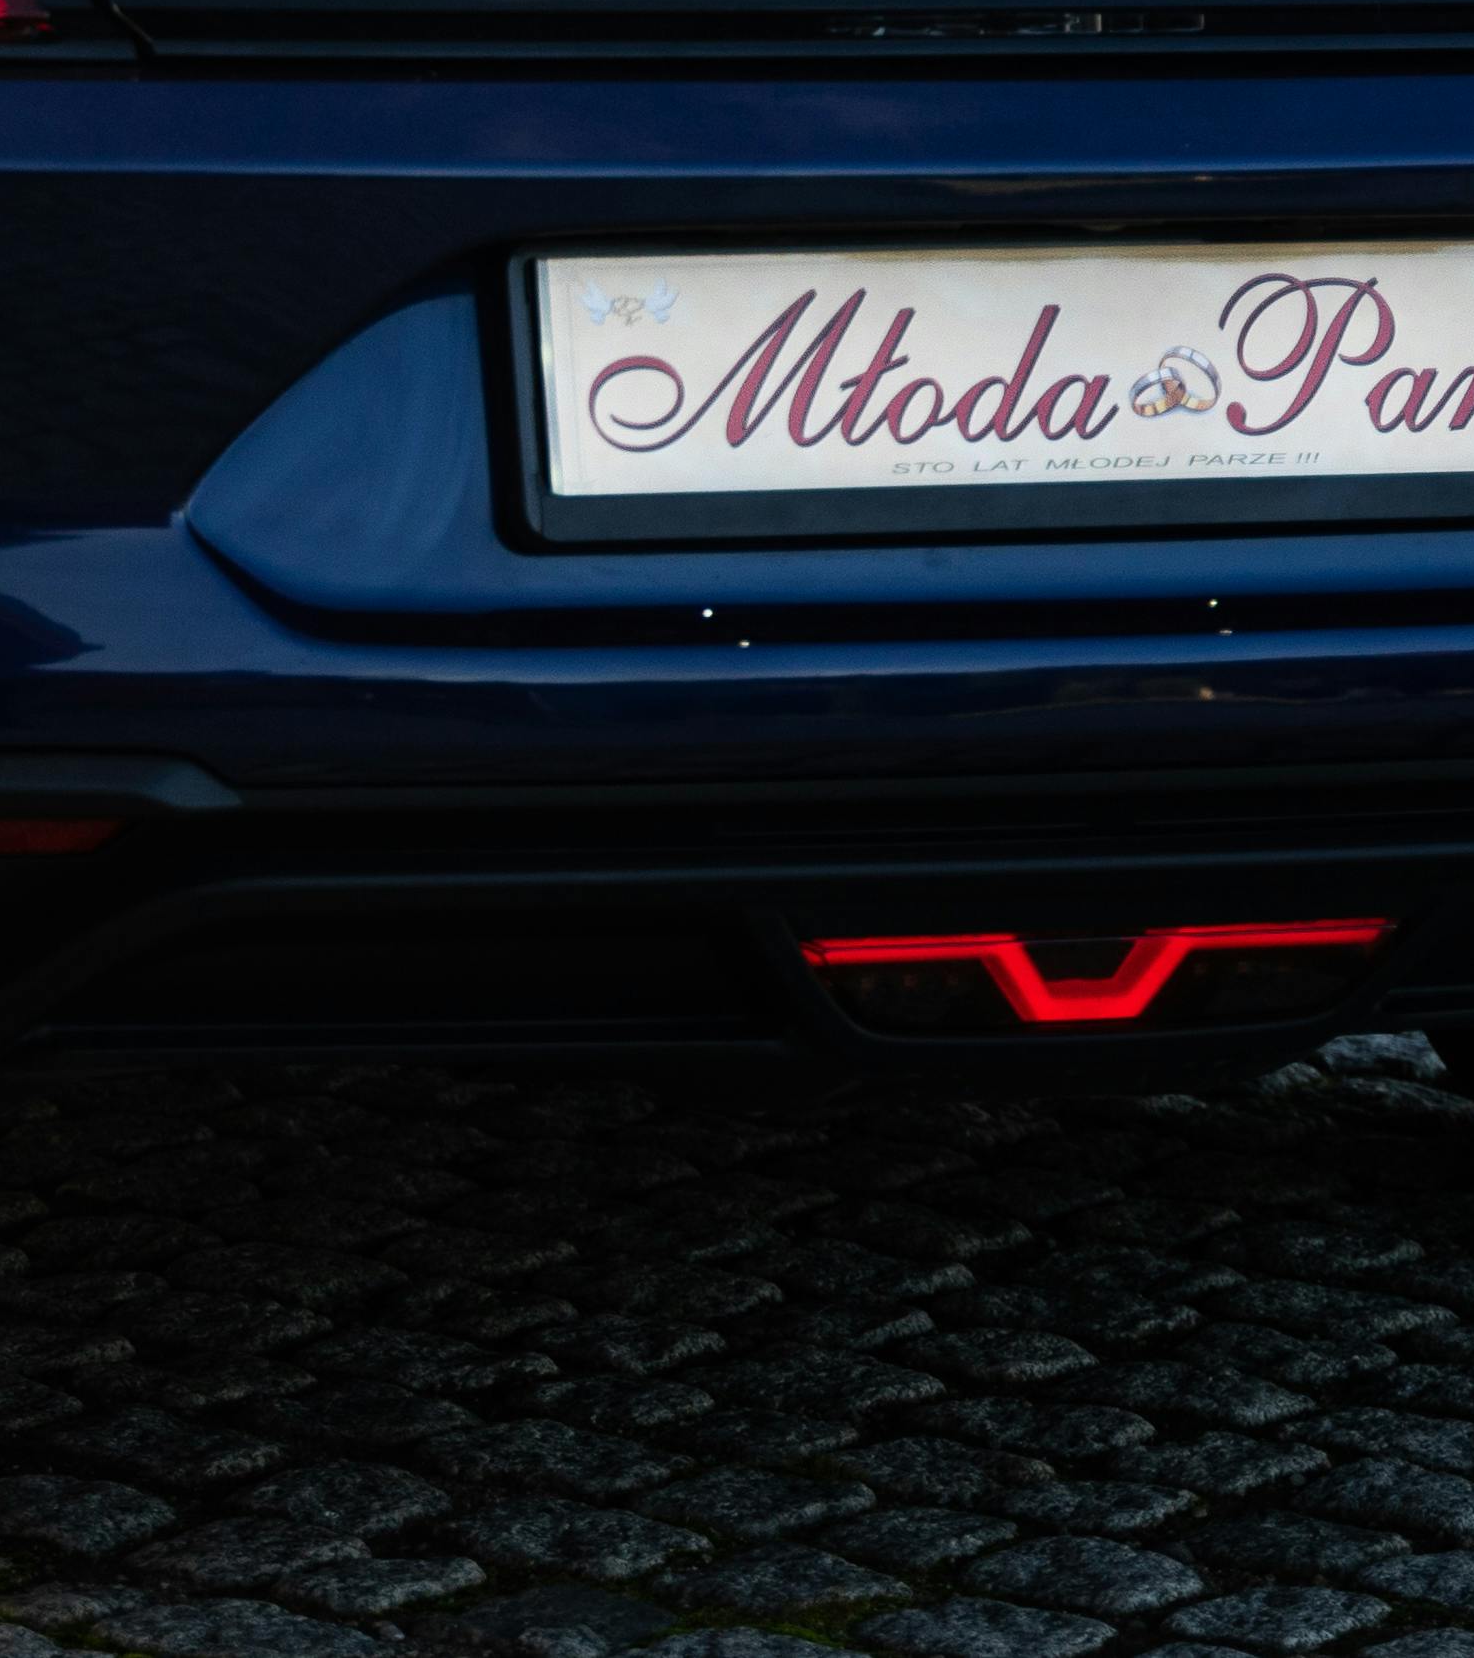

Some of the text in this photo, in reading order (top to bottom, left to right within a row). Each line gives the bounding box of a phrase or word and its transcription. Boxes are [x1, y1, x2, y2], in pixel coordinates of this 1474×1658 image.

[588, 286, 1120, 453] Młoda
[891, 461, 956, 474] STO
[973, 459, 1028, 472] LAT
[1045, 455, 1172, 471] MŁODEJ
[1188, 452, 1287, 467] PARZE
